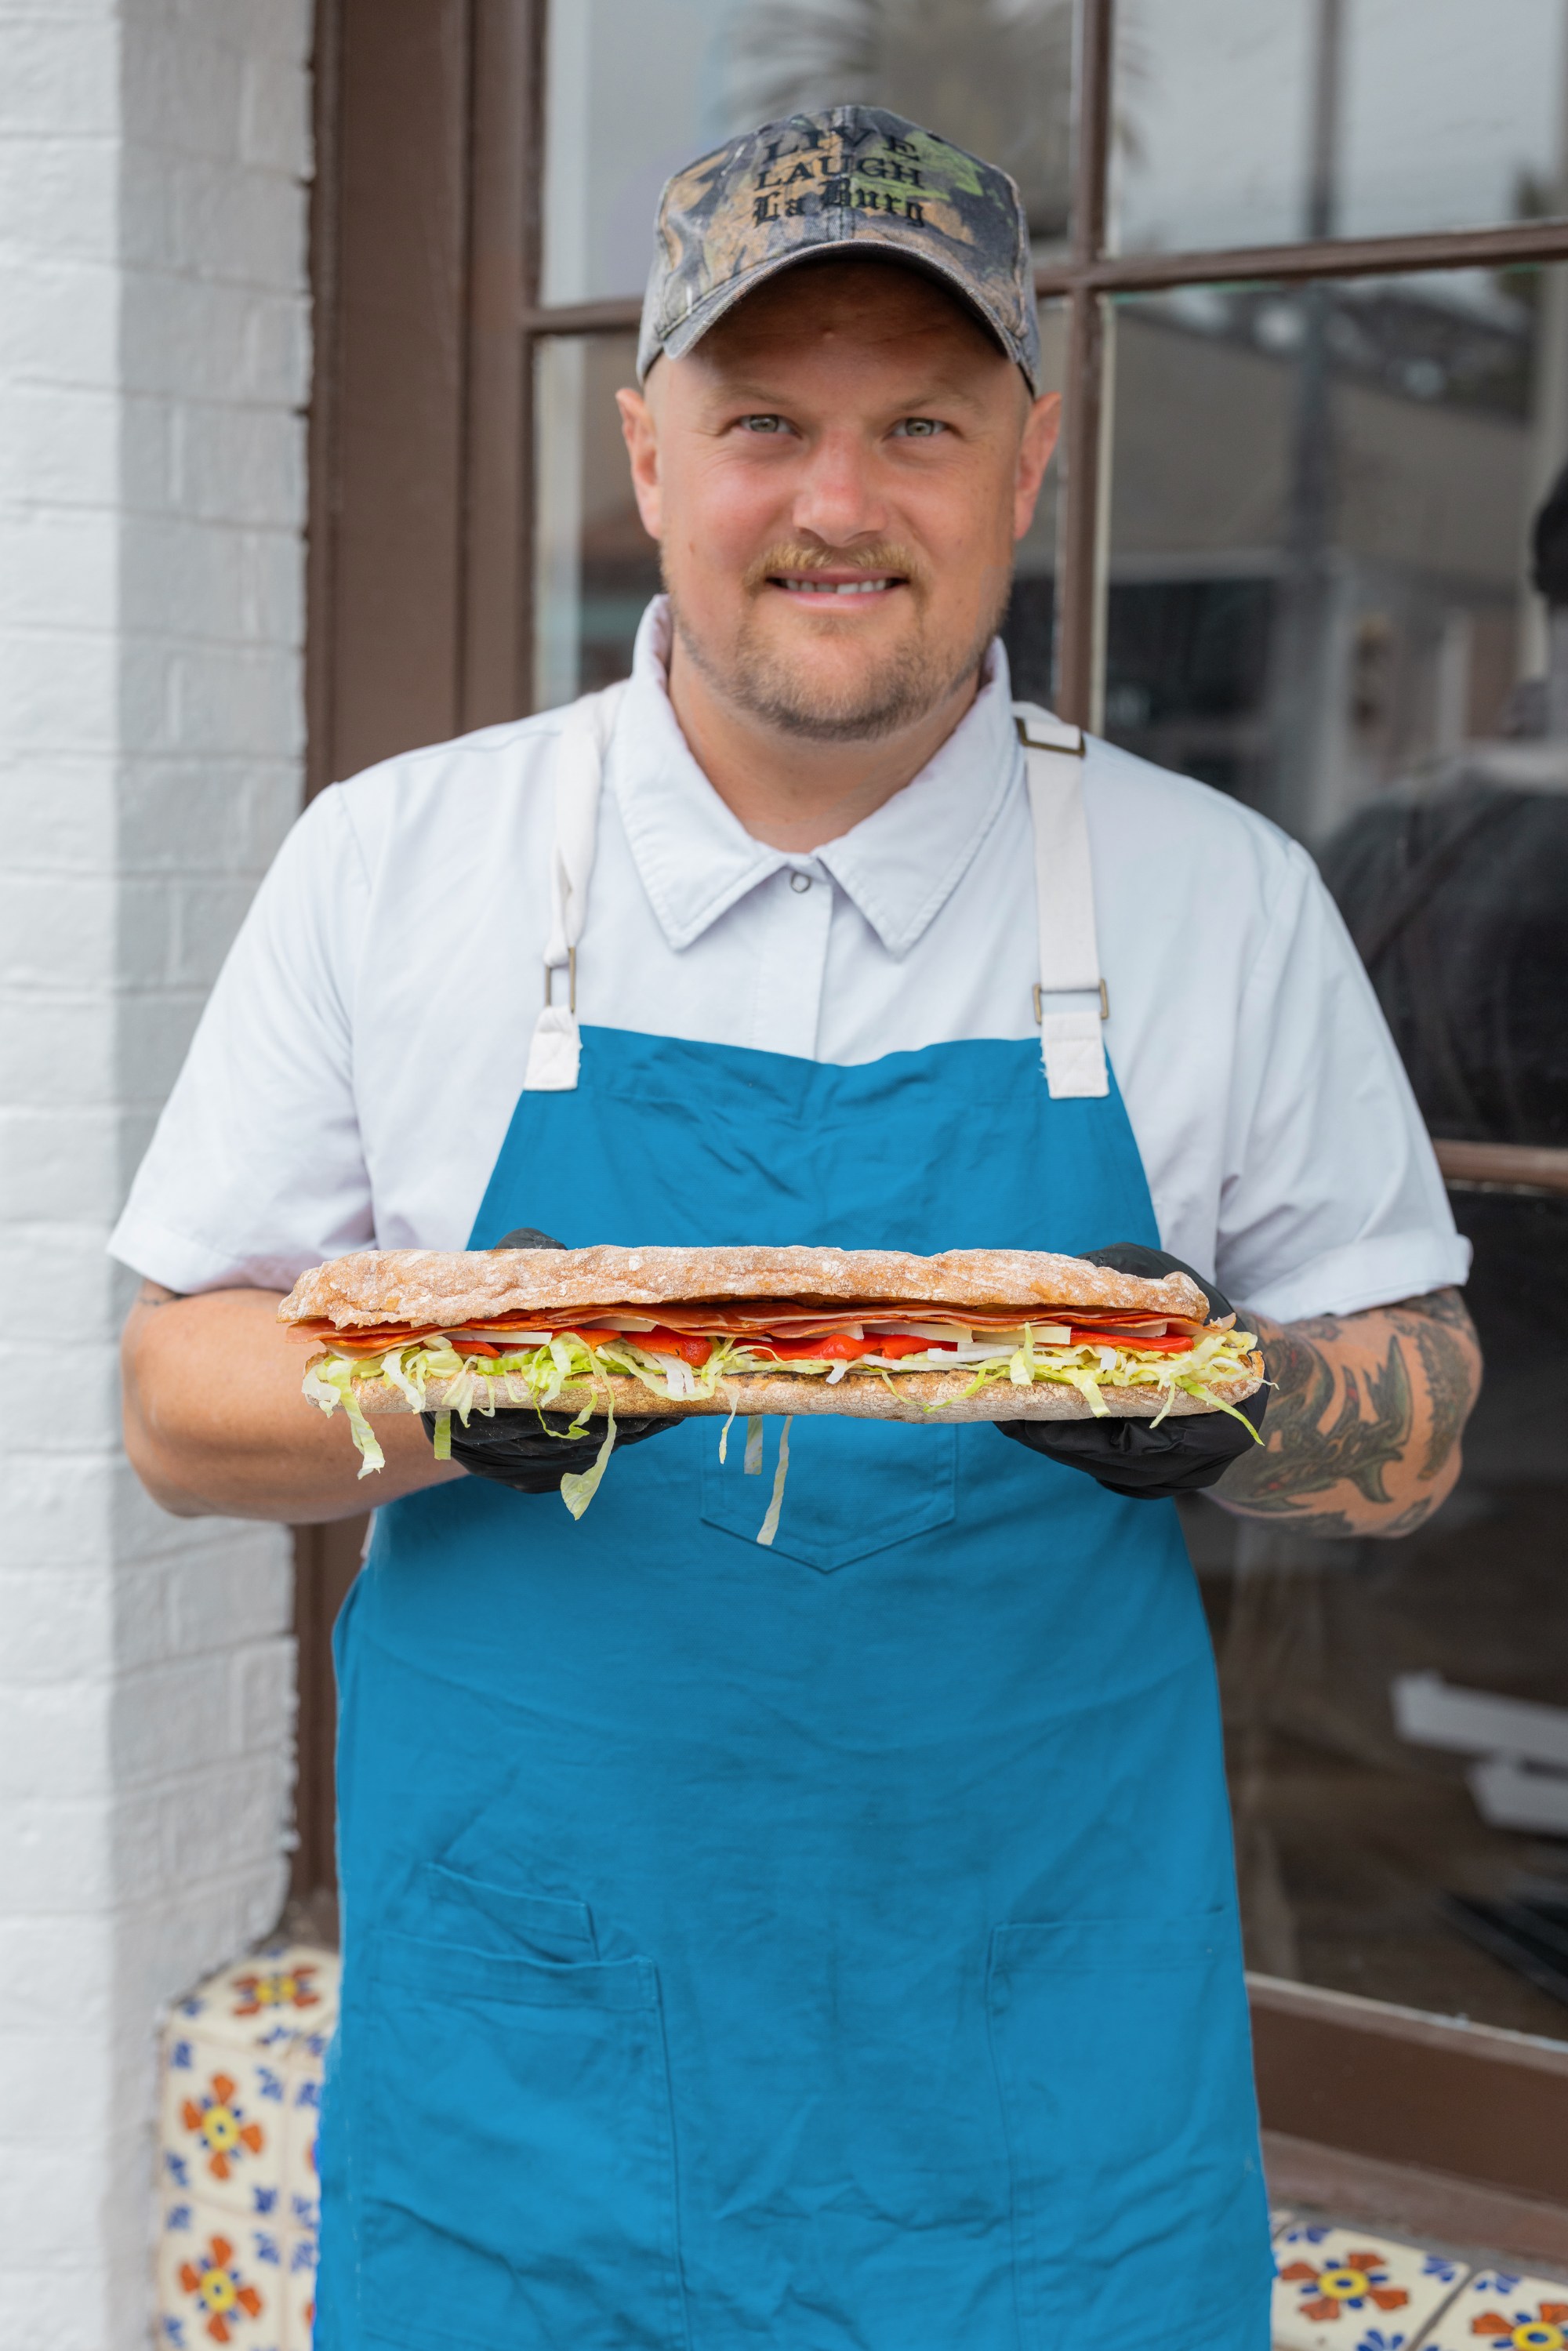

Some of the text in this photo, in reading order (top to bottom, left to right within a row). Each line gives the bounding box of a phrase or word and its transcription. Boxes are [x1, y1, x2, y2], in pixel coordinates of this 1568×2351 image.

[763, 125, 920, 164] LIVE
[754, 155, 926, 190] LAUGH
[753, 177, 925, 228] La Burg
